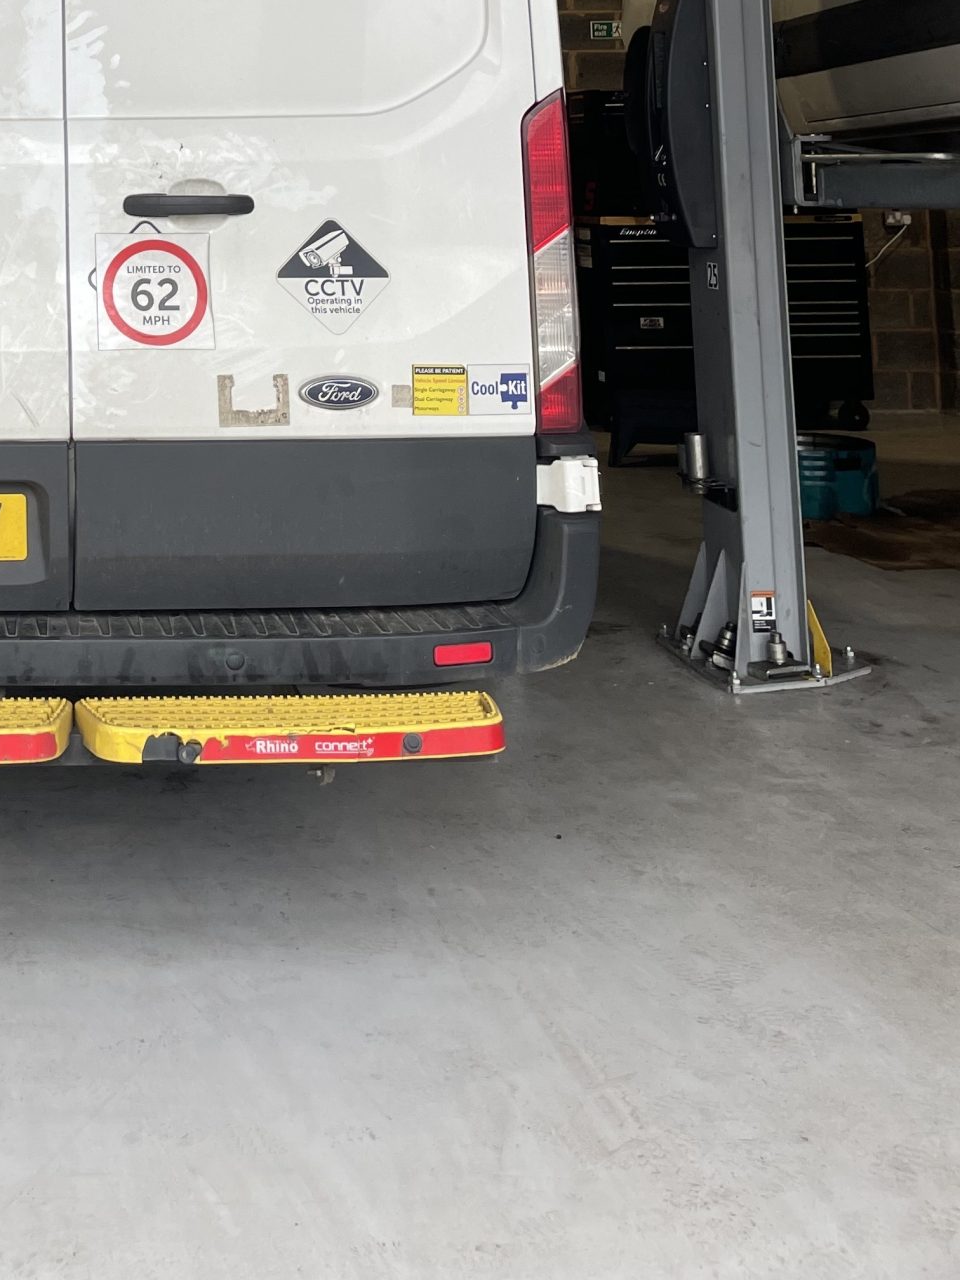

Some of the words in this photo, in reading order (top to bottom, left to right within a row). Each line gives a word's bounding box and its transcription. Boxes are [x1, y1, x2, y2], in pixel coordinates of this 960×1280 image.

[127, 266, 165, 274] LIMITED
[167, 265, 181, 273] TO
[708, 263, 718, 288] 25
[131, 278, 180, 311] 62
[304, 279, 364, 296] CCTV
[307, 297, 352, 306] Operating
[143, 315, 170, 325] MPH
[318, 383, 362, 401] Ford
[472, 381, 499, 395] Cool
[508, 380, 527, 395] Kit
[256, 740, 299, 753] Rhino
